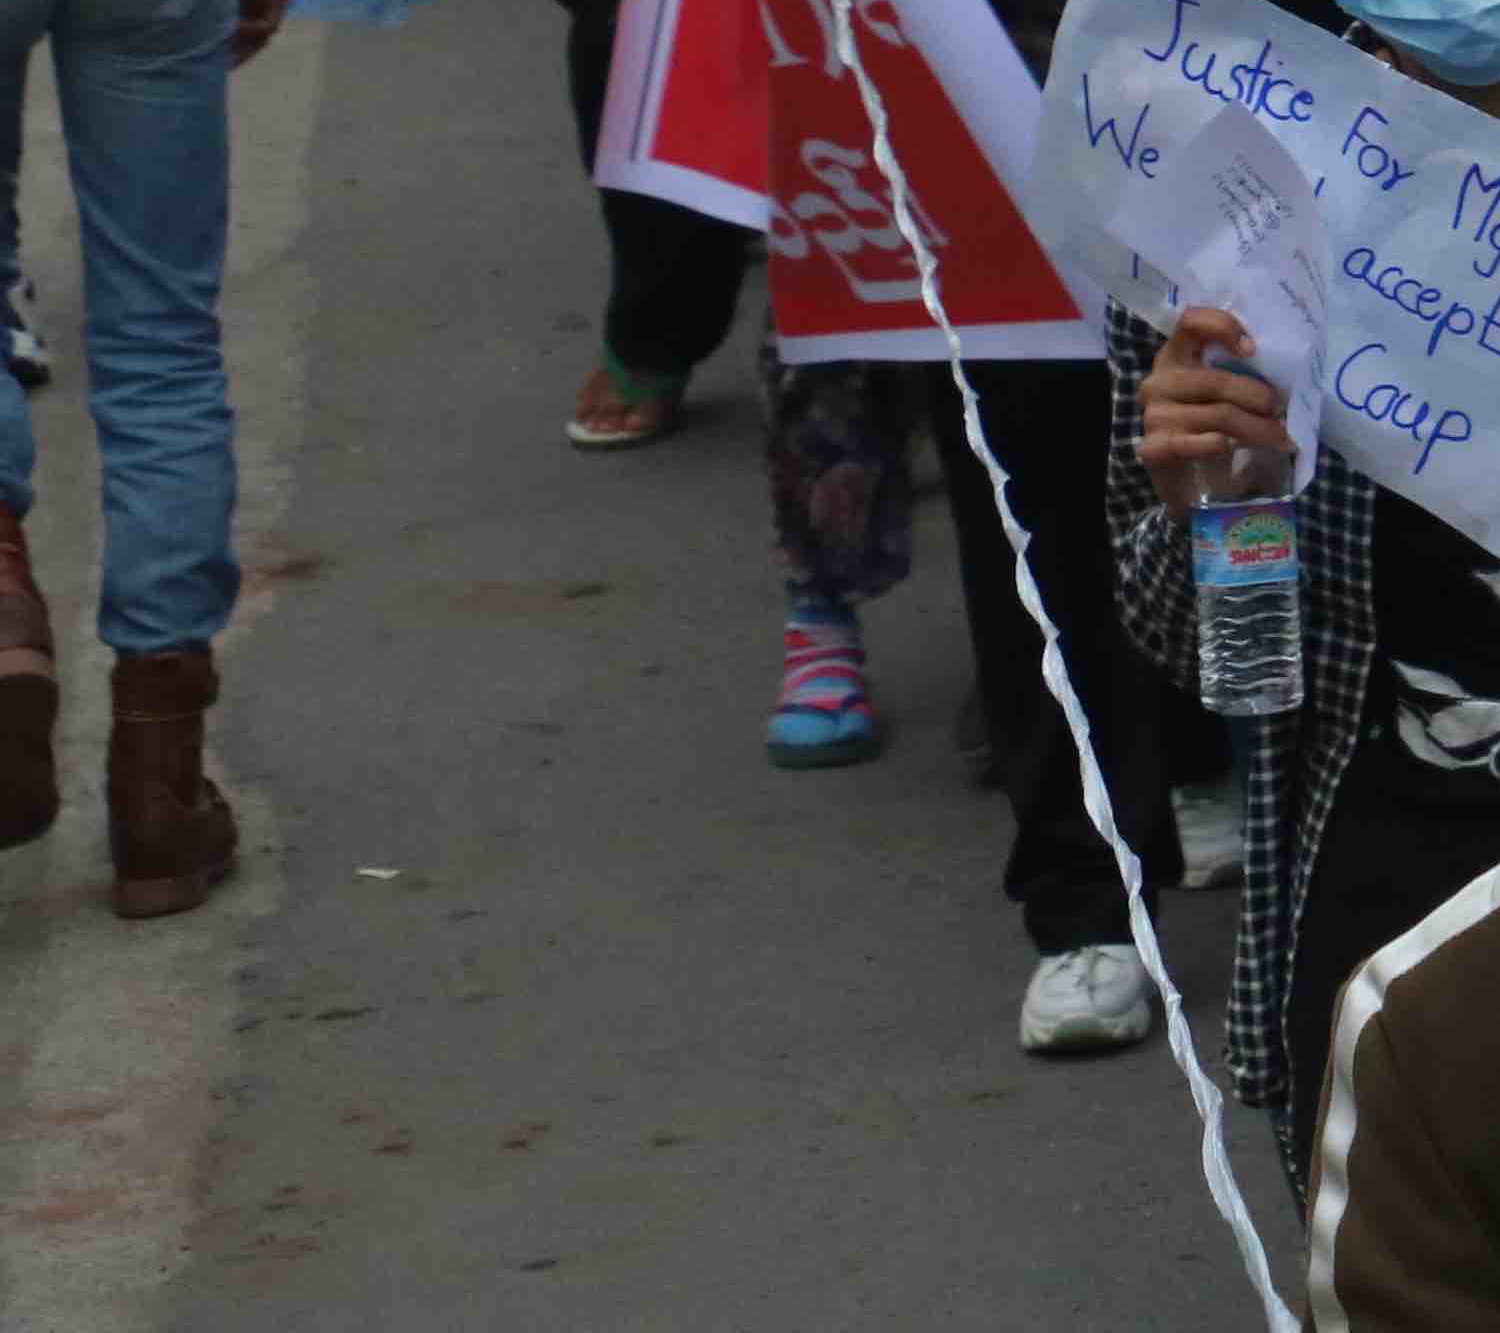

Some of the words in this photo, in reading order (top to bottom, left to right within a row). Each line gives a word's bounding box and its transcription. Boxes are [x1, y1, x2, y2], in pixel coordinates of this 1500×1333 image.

[1082, 73, 1162, 179] We
[1340, 106, 1416, 194] For
[1334, 342, 1475, 476] Coup
